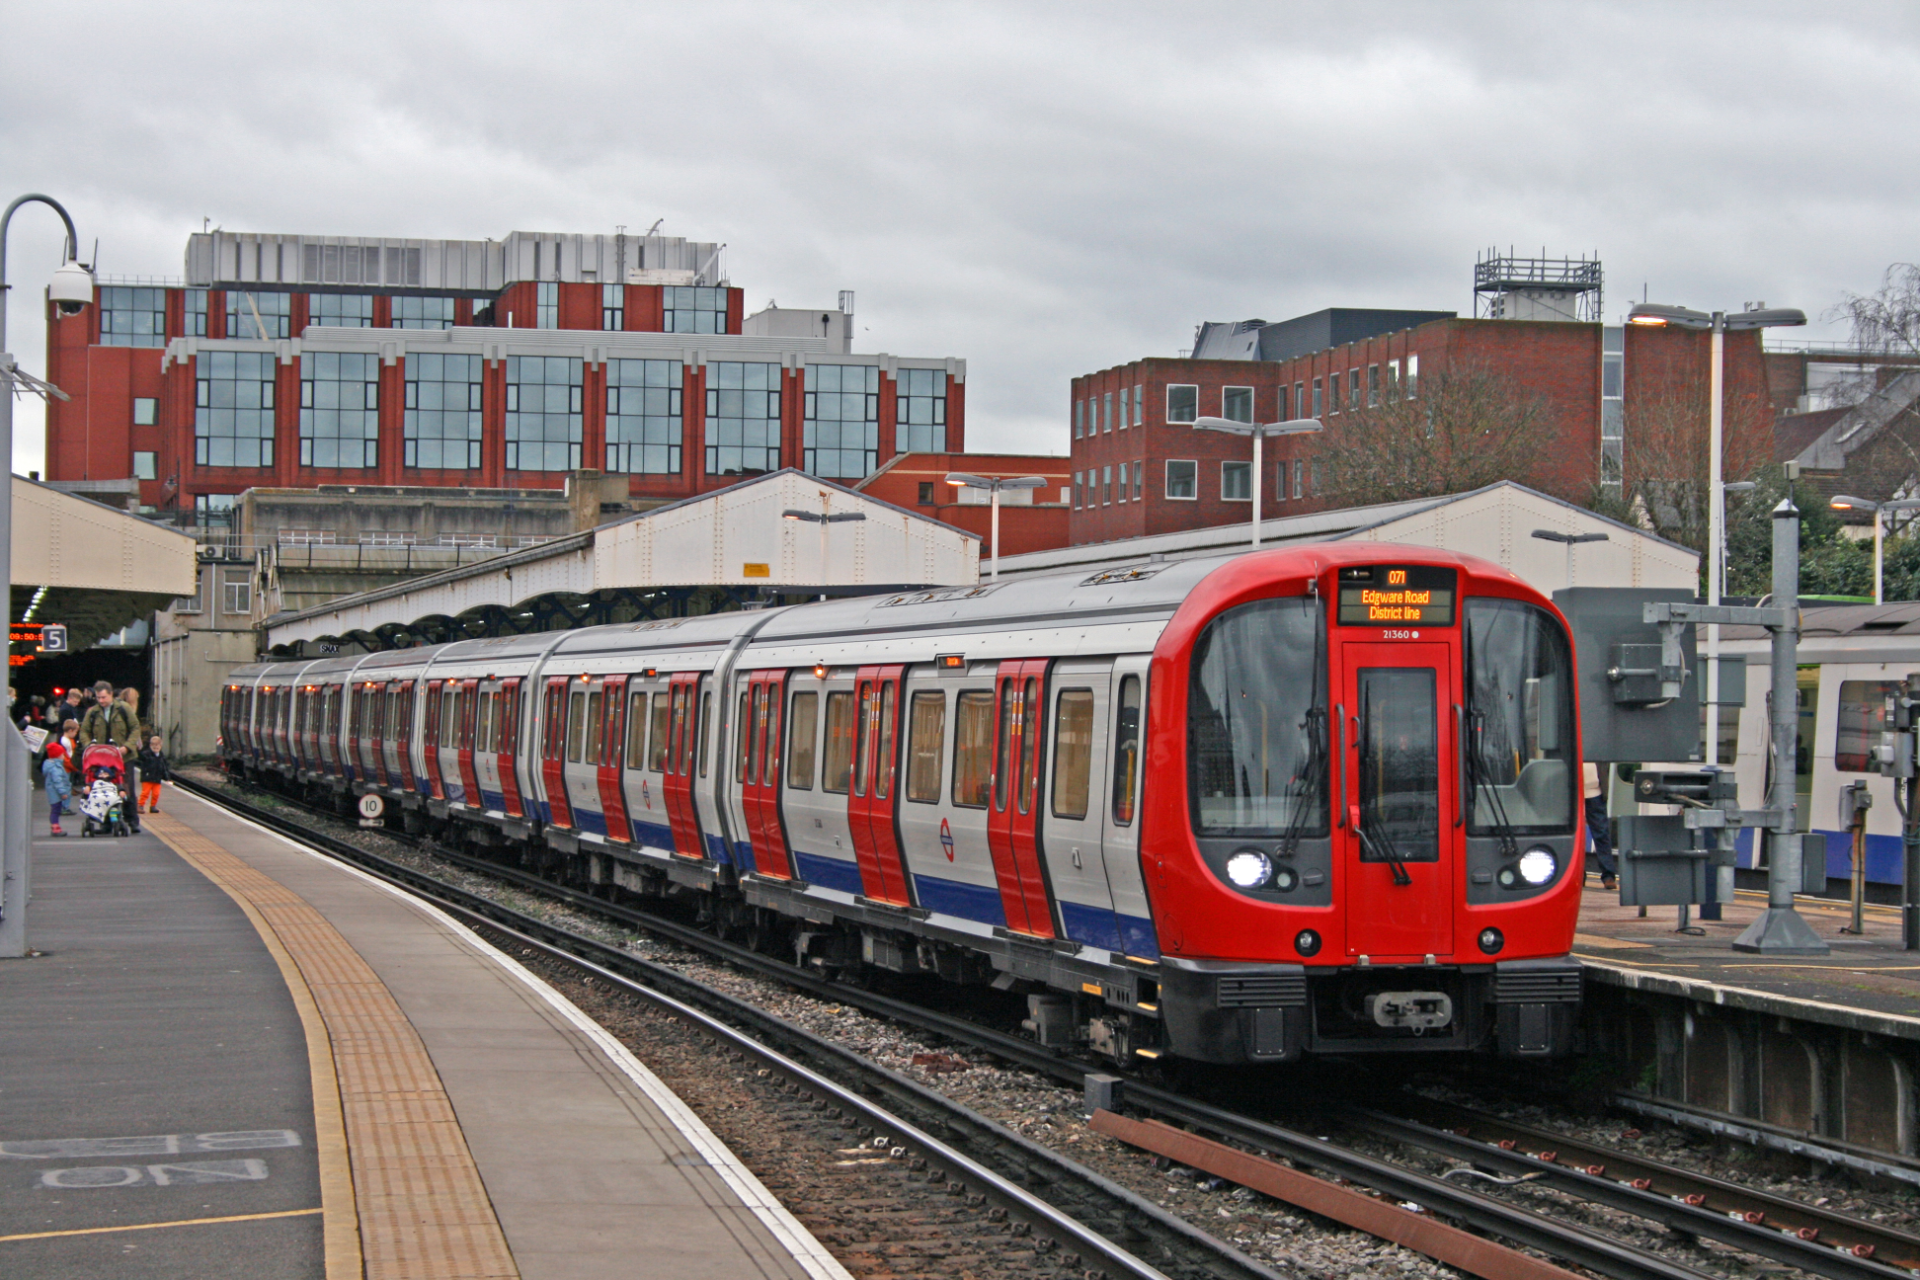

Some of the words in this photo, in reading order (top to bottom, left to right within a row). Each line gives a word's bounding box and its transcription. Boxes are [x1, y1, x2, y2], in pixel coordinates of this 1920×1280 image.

[1388, 571, 1406, 584] 071
[1362, 589, 1403, 606] Edgware
[1404, 590, 1430, 604] Road
[1369, 606, 1403, 619] District
[1404, 606, 1421, 619] line
[49, 631, 61, 648] 5
[1383, 630, 1410, 639] 21360
[365, 800, 377, 811] 10
